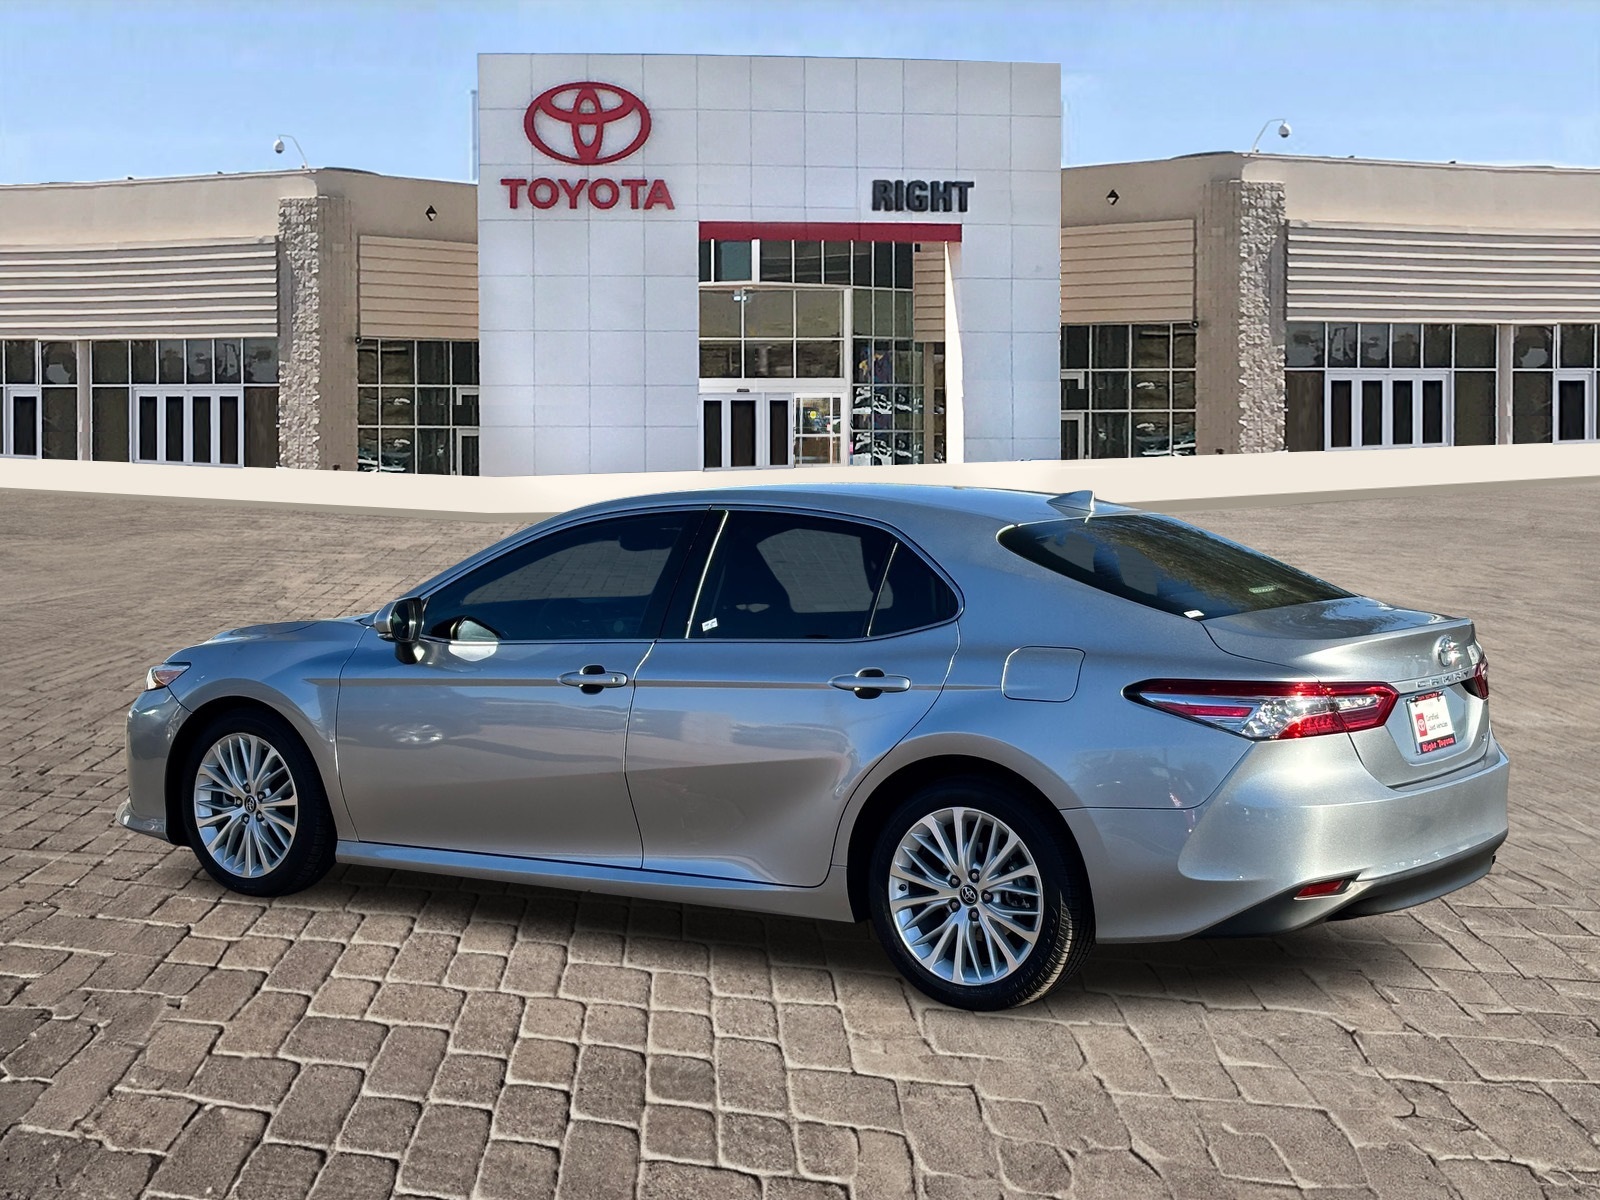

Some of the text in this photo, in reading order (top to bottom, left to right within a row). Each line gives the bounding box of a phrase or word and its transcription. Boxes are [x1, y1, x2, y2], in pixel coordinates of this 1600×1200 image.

[500, 177, 675, 209] TOYOTA
[872, 179, 975, 212] RIGHT
[1422, 742, 1437, 752] Right
